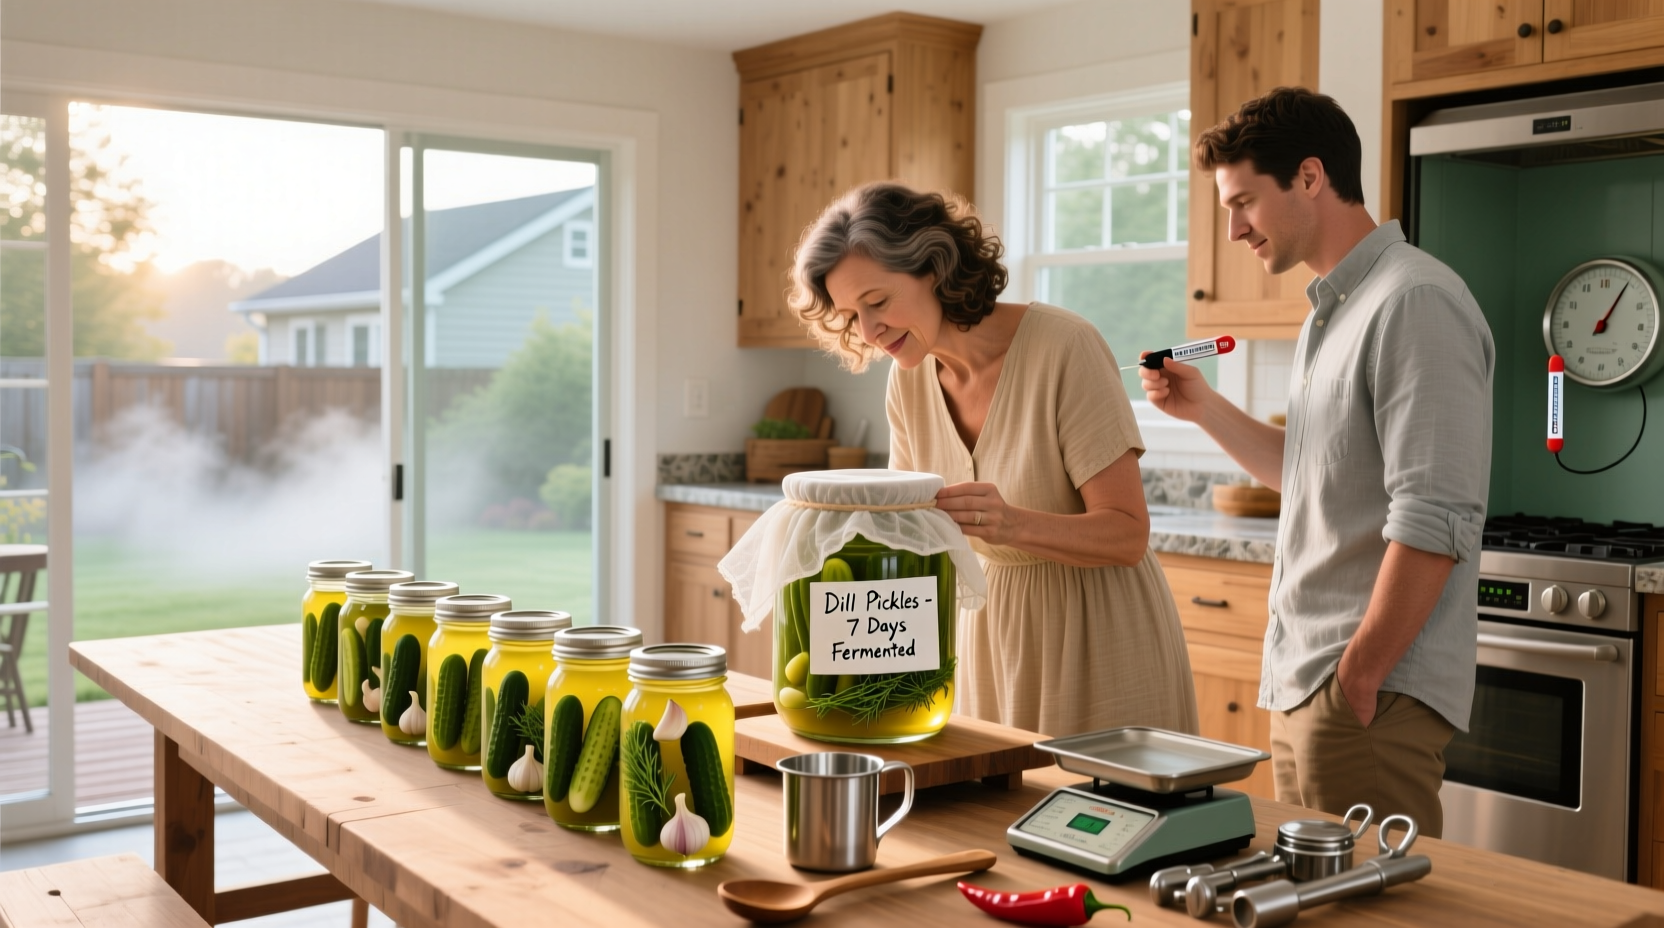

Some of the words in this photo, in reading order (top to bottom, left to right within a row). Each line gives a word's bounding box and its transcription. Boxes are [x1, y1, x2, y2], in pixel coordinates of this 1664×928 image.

[825, 592, 856, 614] Dill
[866, 590, 919, 611] Pickles
[847, 618, 860, 637] 7
[867, 617, 907, 641] Days
[832, 638, 915, 661] Fermented
